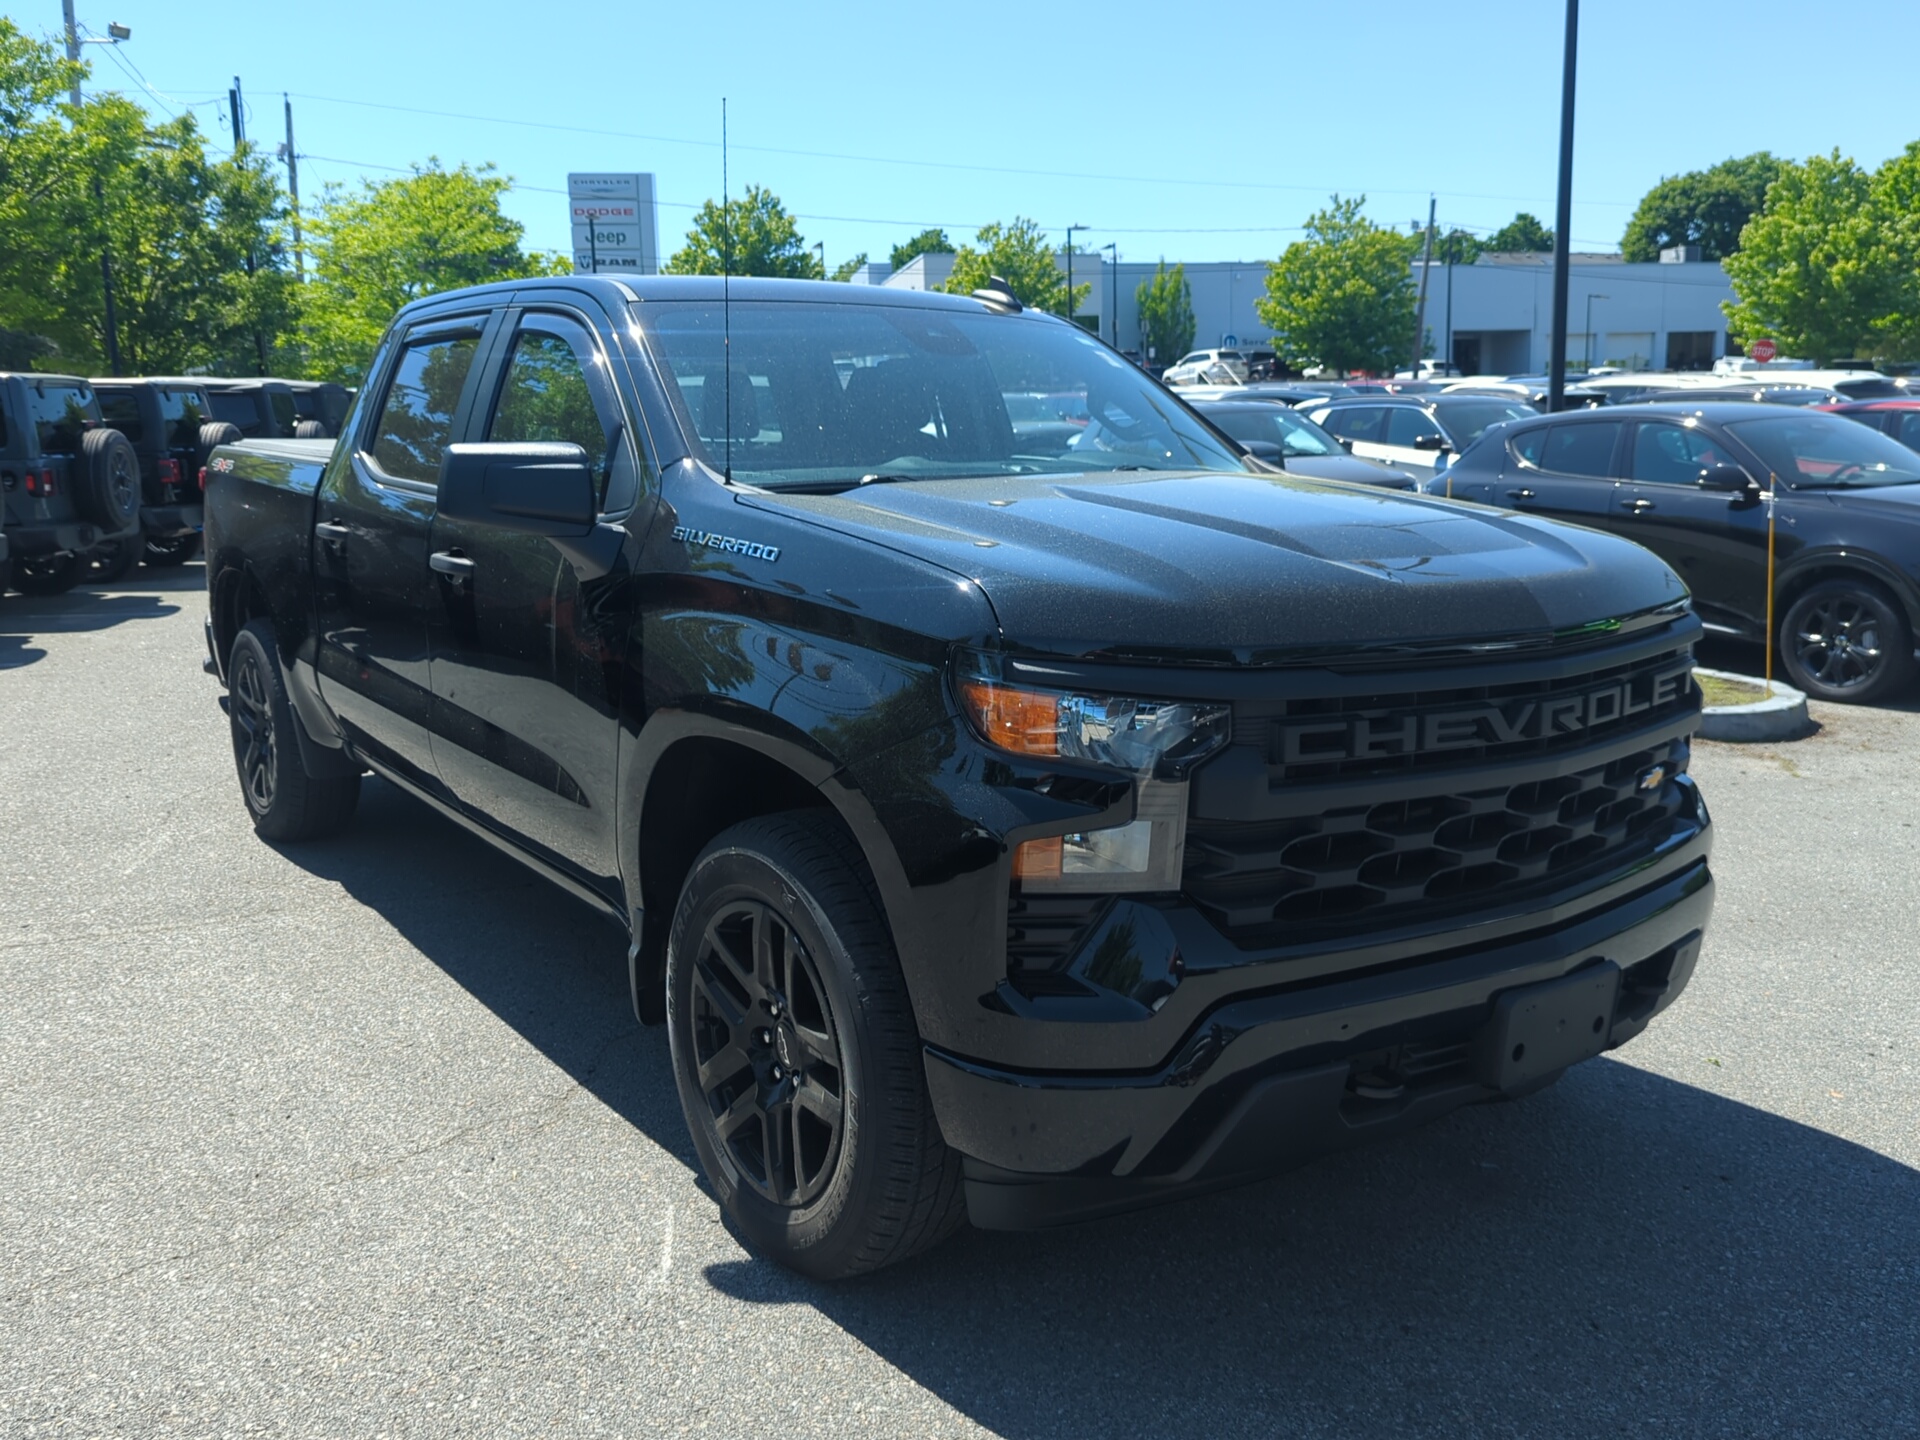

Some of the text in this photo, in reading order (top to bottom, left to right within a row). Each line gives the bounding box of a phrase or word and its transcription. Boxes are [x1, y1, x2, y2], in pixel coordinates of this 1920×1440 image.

[574, 208, 634, 216] DODGE
[595, 258, 637, 267] RAM
[1752, 347, 1775, 357] STOP
[671, 526, 781, 562] SILVERADO
[1274, 667, 1694, 764] CHEVROLET
[667, 889, 699, 1021] GENERAL
